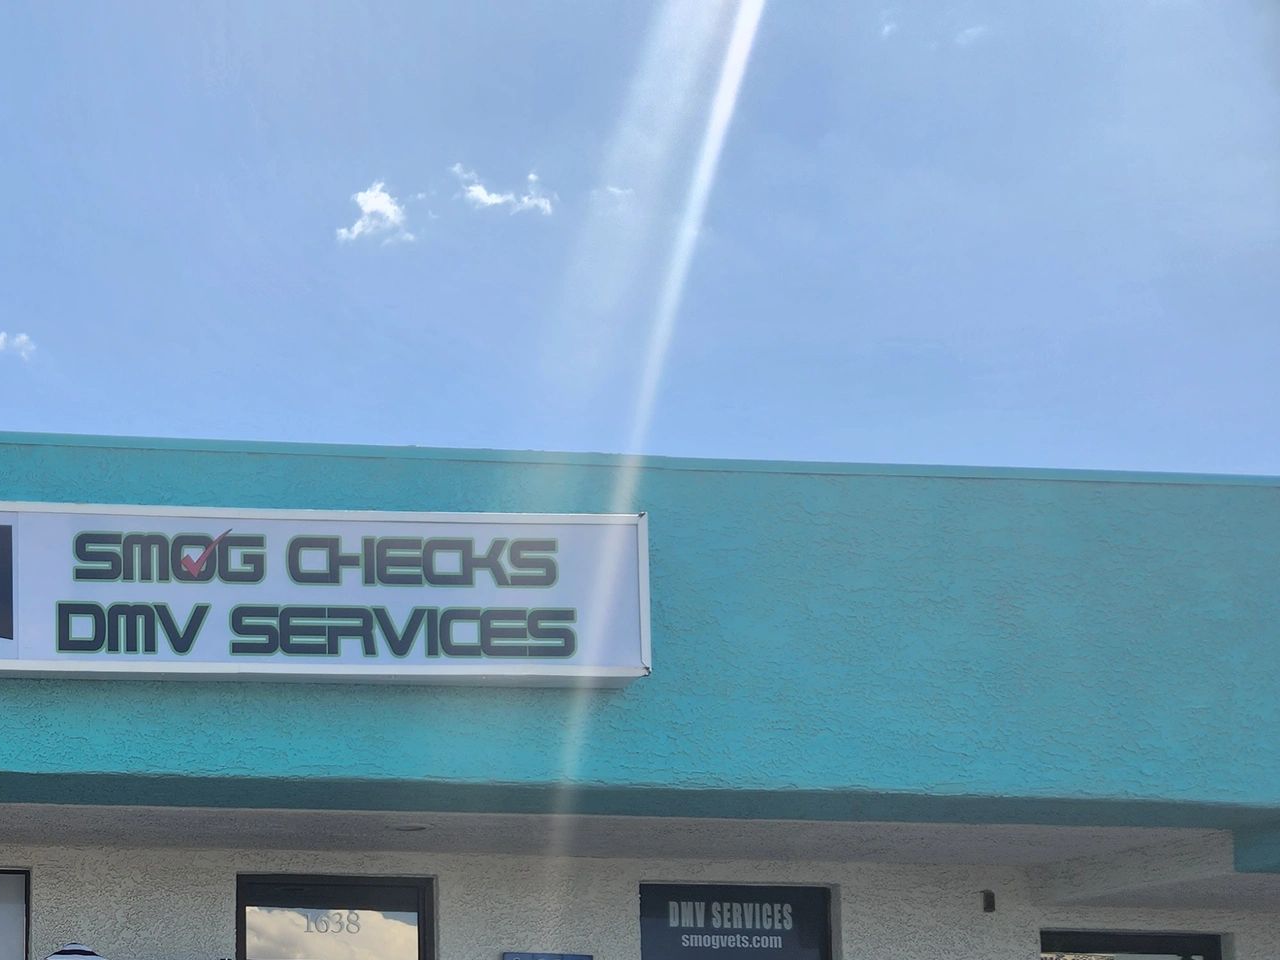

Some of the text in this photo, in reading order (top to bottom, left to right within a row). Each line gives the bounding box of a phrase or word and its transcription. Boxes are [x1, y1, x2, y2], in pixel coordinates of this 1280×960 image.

[73, 530, 559, 588] SMOG CHECKS
[56, 600, 579, 658] DMV SERVICES
[303, 912, 361, 934] 1638
[668, 901, 793, 930] DMV SERVICES
[681, 932, 782, 949] smogvets.com
